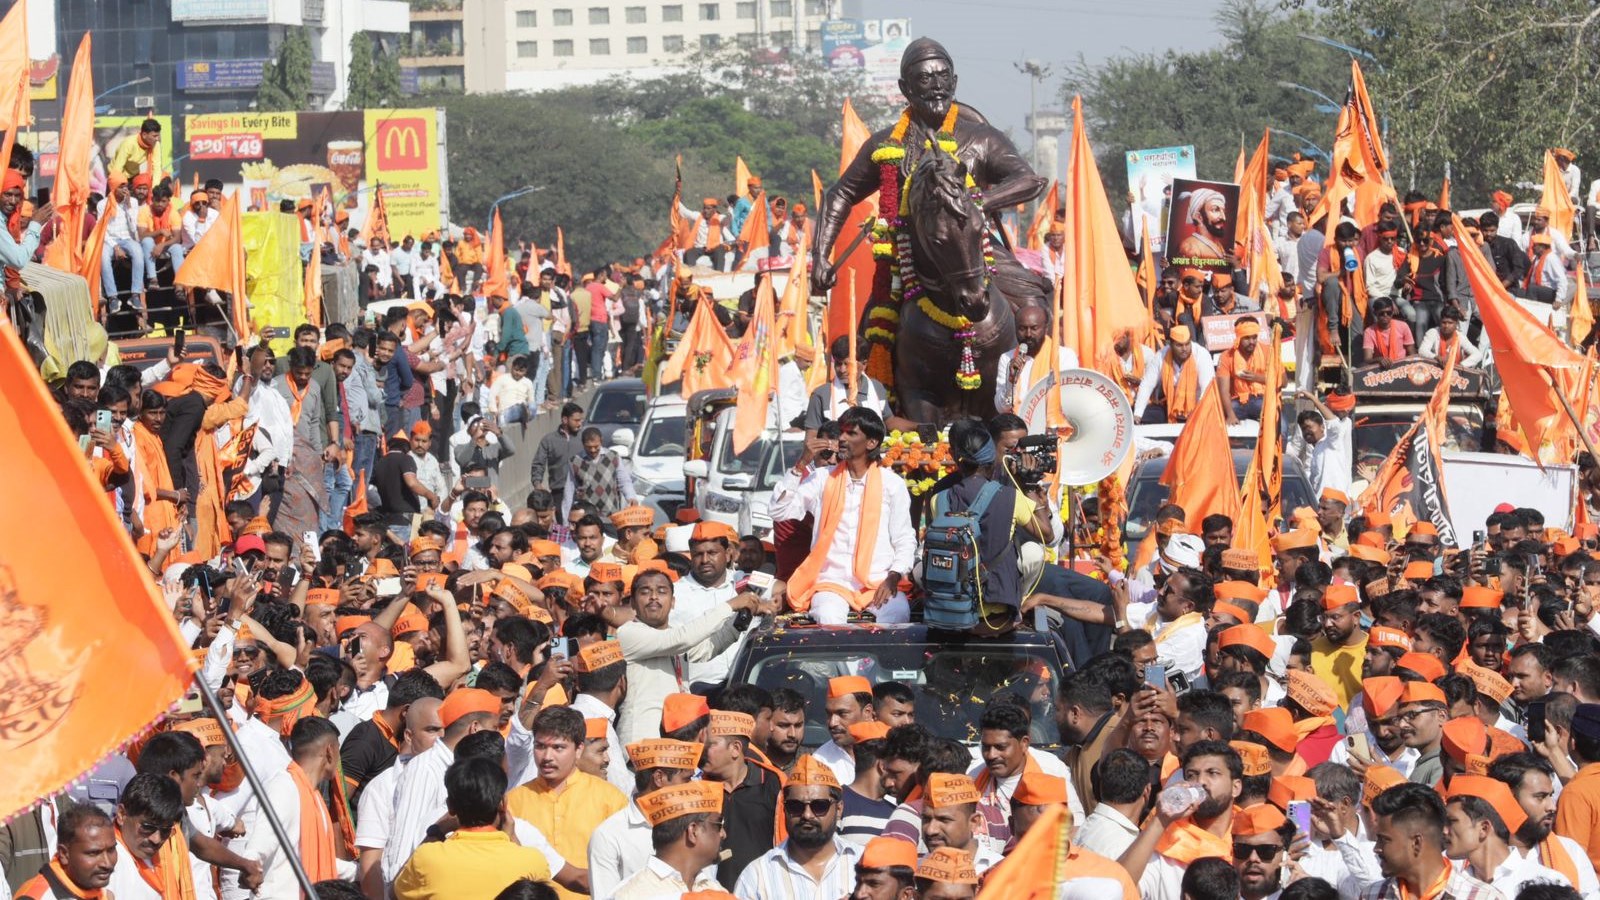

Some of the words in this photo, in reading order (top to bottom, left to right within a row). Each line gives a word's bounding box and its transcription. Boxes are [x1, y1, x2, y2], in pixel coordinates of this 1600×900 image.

[190, 118, 228, 130] Savings
[231, 117, 240, 128] In
[242, 116, 269, 130] Every
[272, 116, 291, 127] Bite
[932, 556, 952, 568] LiveU
[657, 756, 694, 765] मराठा
[649, 792, 675, 807] एक
[941, 792, 974, 802] लाख
[650, 802, 684, 820] लाख
